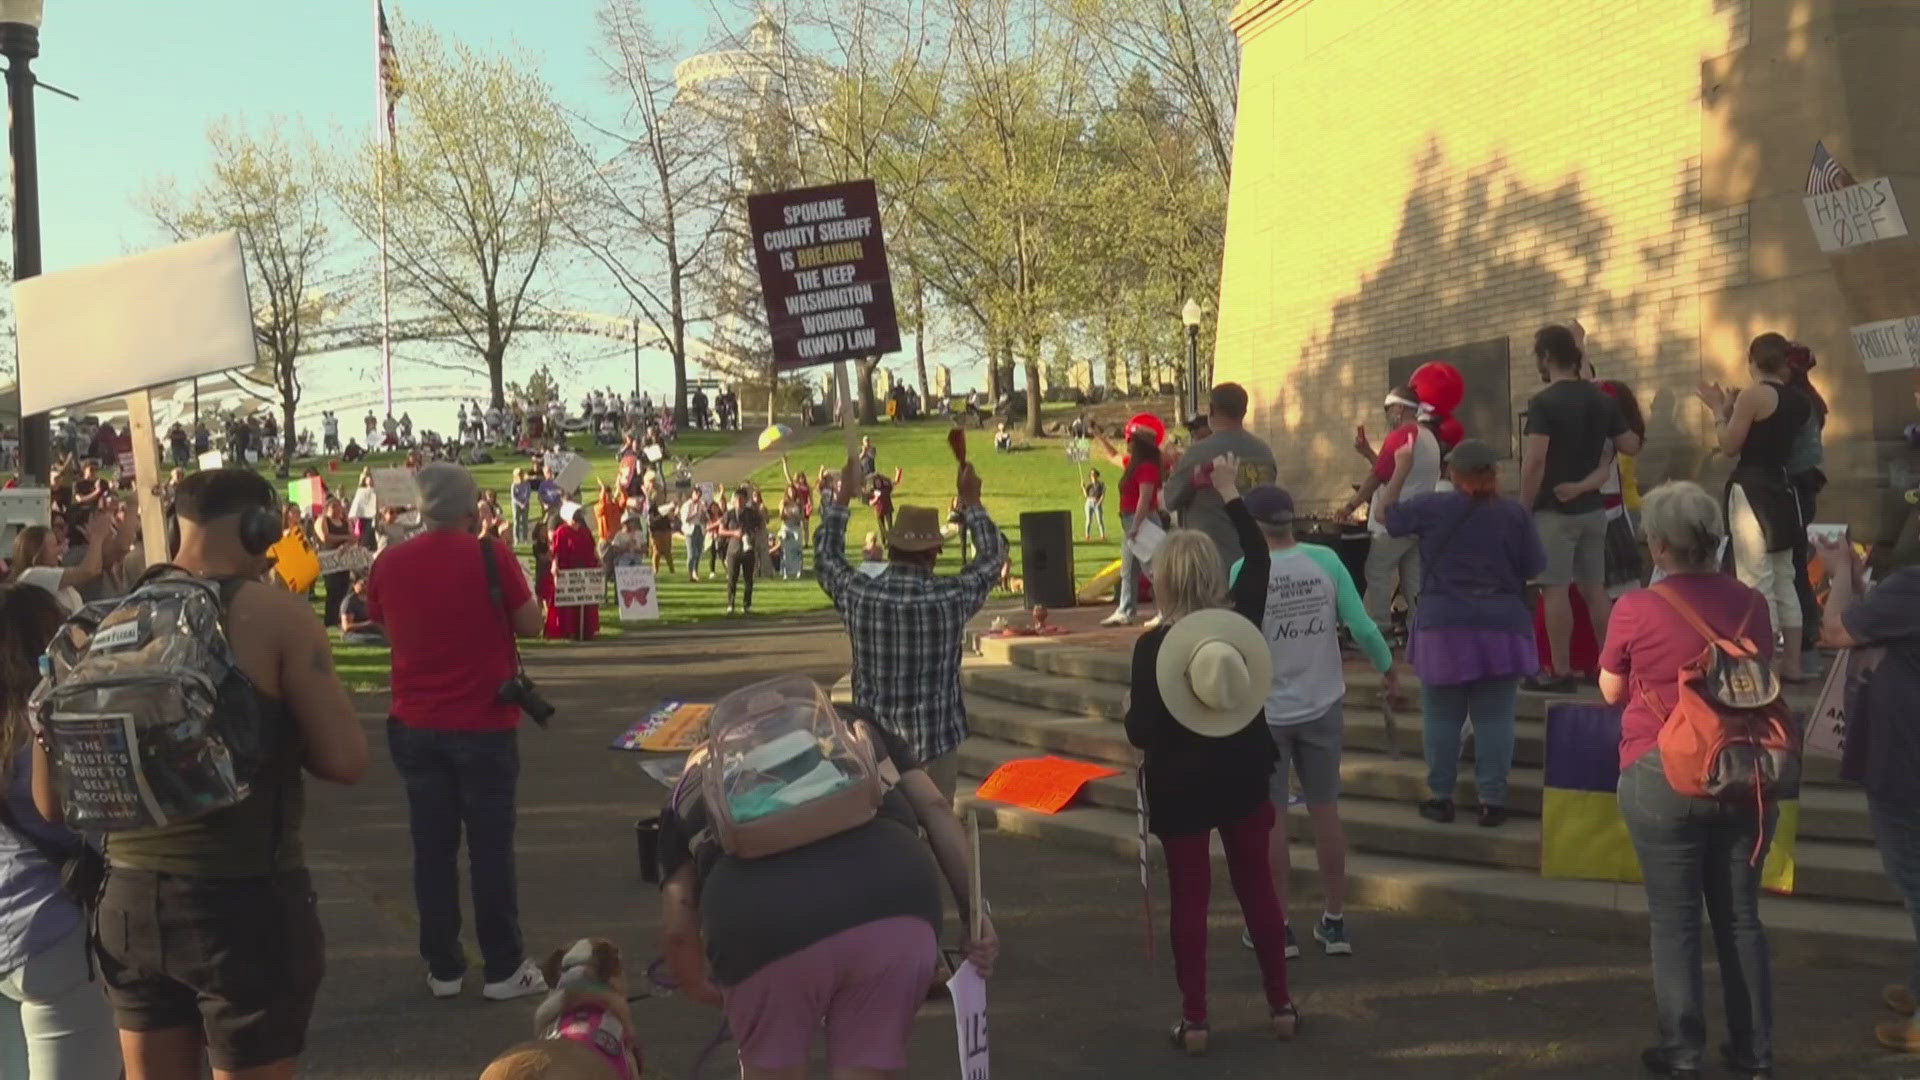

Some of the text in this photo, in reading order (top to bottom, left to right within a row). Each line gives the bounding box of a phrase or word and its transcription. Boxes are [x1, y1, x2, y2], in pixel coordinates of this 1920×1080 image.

[783, 198, 846, 226] SPOKANE
[1813, 179, 1887, 226] HANDS
[763, 217, 873, 252] COUNTY SHERIFF
[780, 240, 864, 271] IS BREAKING
[794, 264, 856, 291] THE KEEP
[785, 284, 873, 316] WASHINGTON
[801, 307, 865, 336] WORKING
[797, 328, 876, 359] (KWW) LAW
[1855, 325, 1903, 360] PROTECT
[1274, 575, 1290, 585] THE
[1280, 587, 1313, 599] REVIEW
[77, 741, 103, 752] THE
[109, 767, 126, 778] TO
